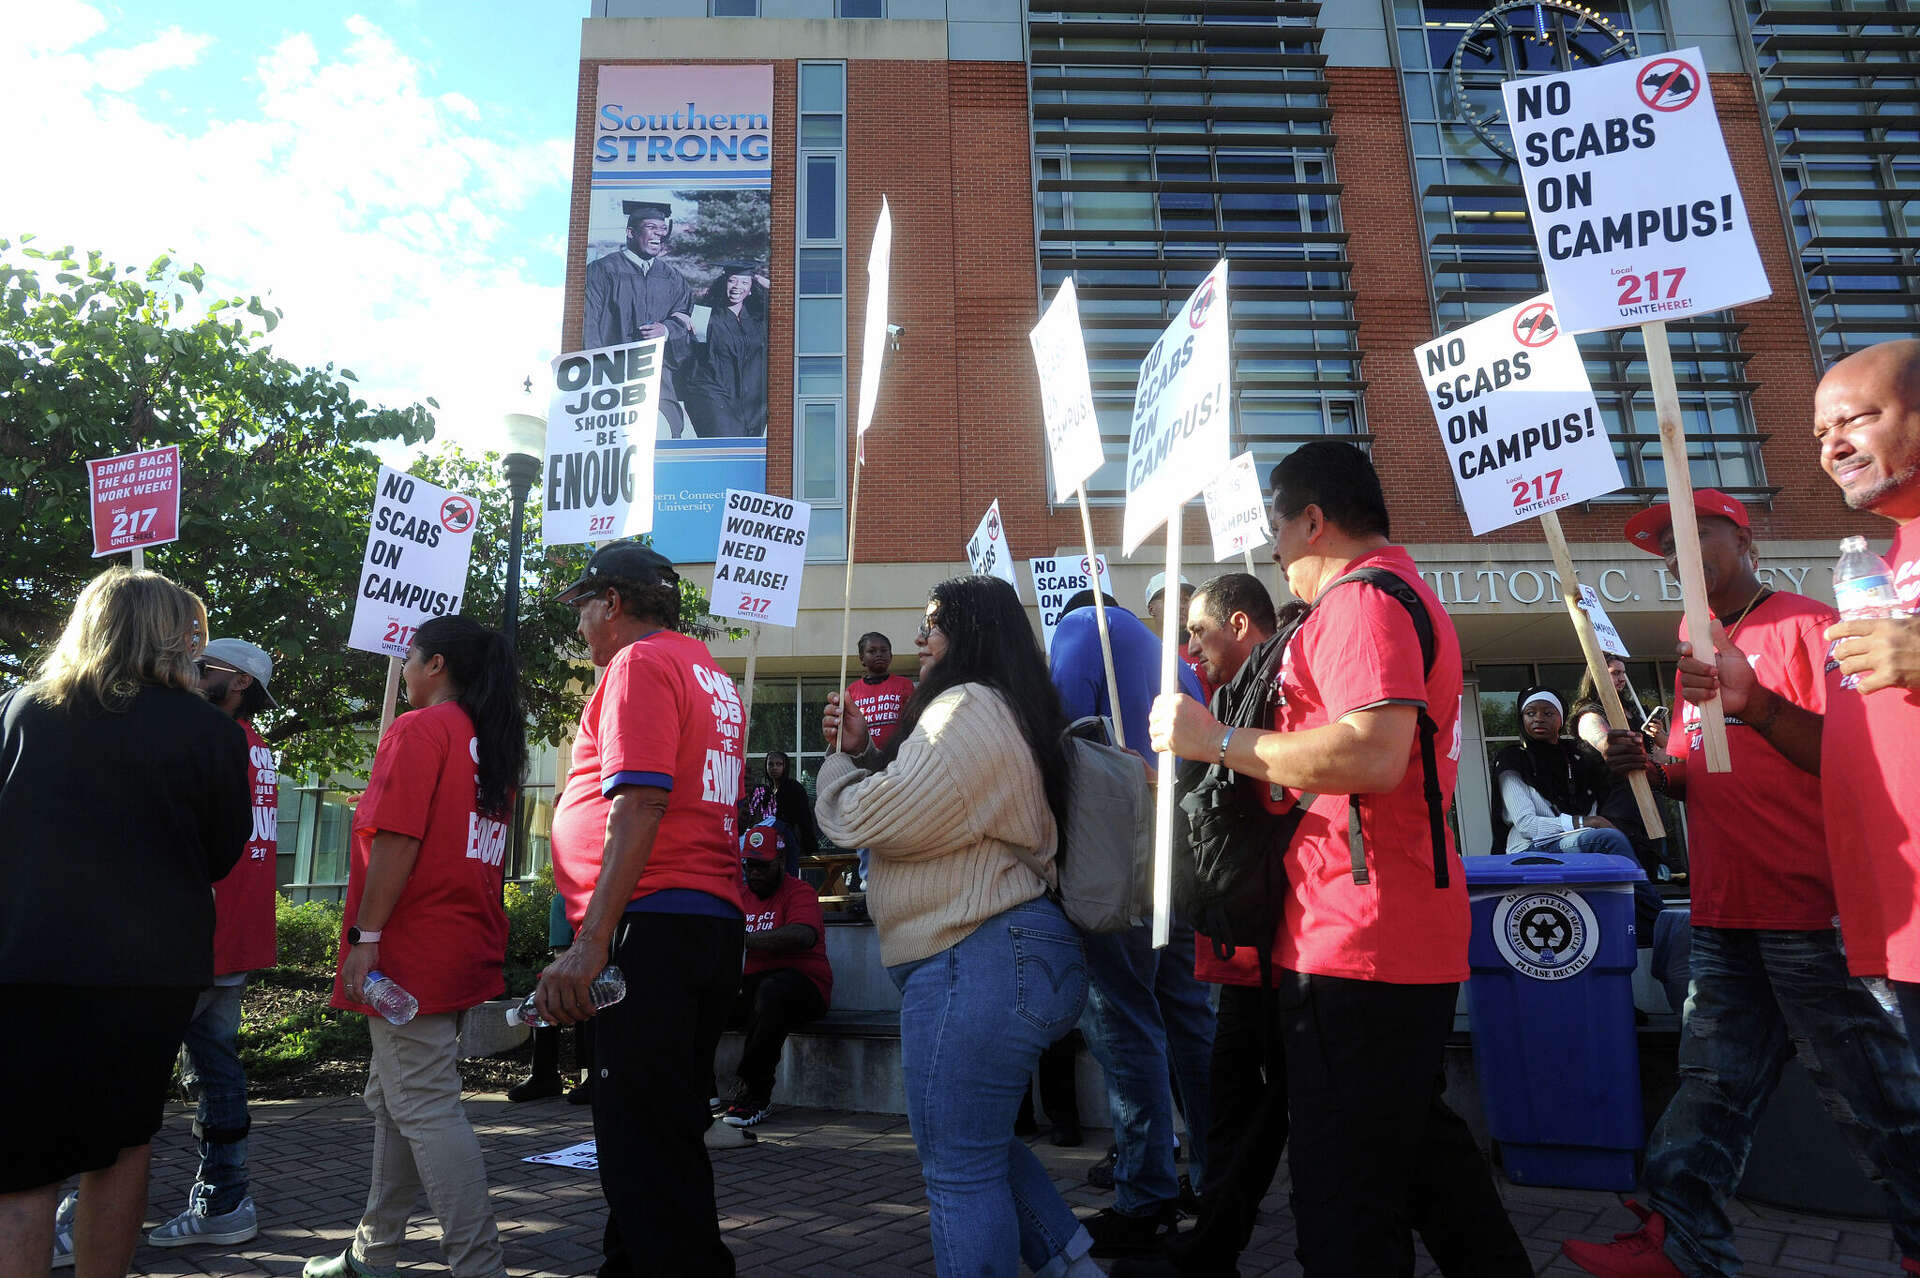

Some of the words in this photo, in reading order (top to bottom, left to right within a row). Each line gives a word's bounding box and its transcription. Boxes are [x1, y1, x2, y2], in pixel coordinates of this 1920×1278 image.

[1517, 80, 1571, 122] NO
[600, 102, 770, 132] Southern
[594, 134, 769, 162] STRONG
[1525, 113, 1656, 168] SCABS
[1537, 171, 1592, 214] ON
[1548, 194, 1733, 261] CAMPUS!
[1610, 266, 1633, 276] Local
[1617, 266, 1686, 306] 217
[1620, 298, 1692, 318] UNITEHERE!
[556, 344, 657, 392] ONE
[1140, 339, 1164, 388] NO
[1426, 338, 1466, 376] NO
[1135, 334, 1195, 422] SCABS
[1436, 351, 1532, 410] SCABS
[565, 383, 647, 414] JOB
[575, 410, 638, 432] SHOULD
[1132, 406, 1160, 456] ON
[1448, 406, 1488, 444] ON
[1130, 383, 1222, 493] CAMPUS!
[1458, 407, 1595, 480] CAMPUS!
[97, 460, 135, 476] BRING
[140, 452, 172, 468] BACK
[98, 476, 120, 490] THE
[122, 472, 136, 484] 40
[138, 466, 172, 481] HOUR
[548, 445, 638, 512] ENOUG
[1506, 474, 1522, 484] Local
[98, 487, 132, 503] WORK
[134, 480, 172, 496] WEEK!
[382, 473, 415, 504] NO
[1512, 468, 1563, 508] 217
[112, 506, 126, 514] Local
[658, 500, 714, 512] University
[728, 493, 794, 520] SODEXO
[1514, 492, 1570, 516] UNITEHERE!
[110, 508, 158, 538] 217
[376, 506, 442, 548] SCABS
[589, 516, 616, 531] 217
[726, 516, 805, 546] WORKERS
[370, 540, 404, 570] ON
[721, 540, 766, 562] NEED
[970, 536, 980, 565] NO
[716, 564, 730, 580] A
[732, 565, 789, 591] RAISE!
[1034, 560, 1056, 574] NO
[364, 574, 458, 616] CAMPUS!
[1037, 576, 1088, 591] SCABS
[1600, 568, 1641, 603] C.
[738, 596, 772, 613] 217
[1041, 594, 1063, 608] ON
[384, 622, 418, 646] 217
[692, 664, 740, 706] ONE
[878, 694, 900, 702] BACK
[866, 705, 876, 713] 40
[878, 702, 900, 712] HOUR
[1513, 902, 1530, 921] HOOT
[1540, 898, 1571, 916] PLEASE
[1570, 914, 1582, 952] RECYCLE
[1515, 960, 1551, 978] PLEASE
[1553, 954, 1590, 978] RECYCLE
